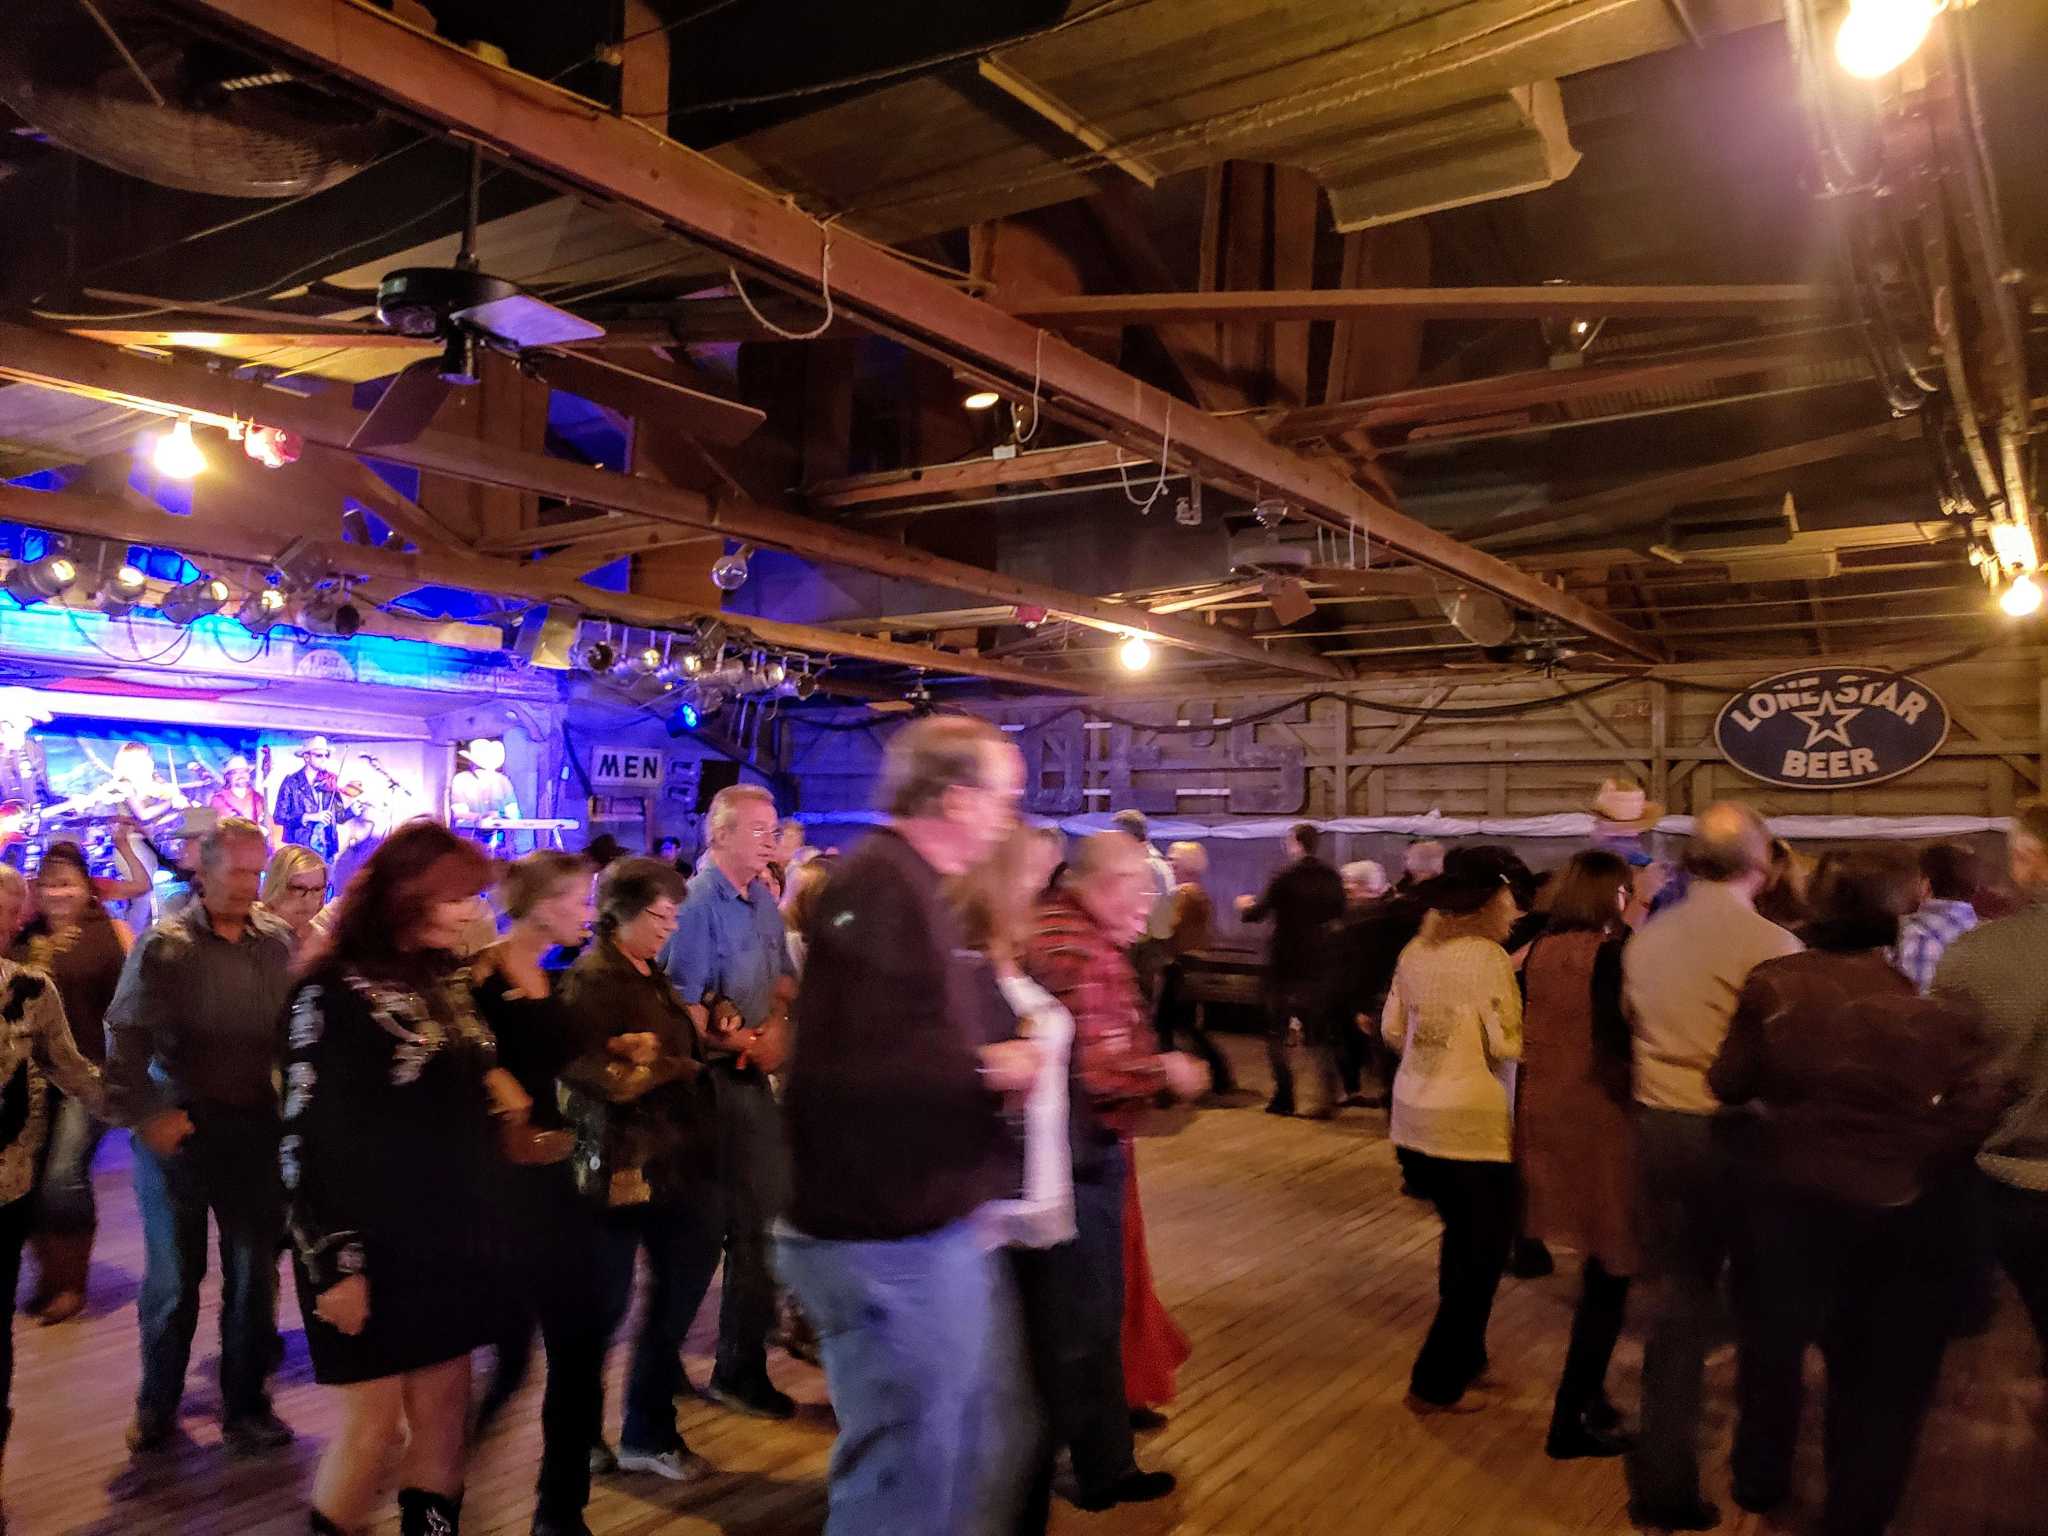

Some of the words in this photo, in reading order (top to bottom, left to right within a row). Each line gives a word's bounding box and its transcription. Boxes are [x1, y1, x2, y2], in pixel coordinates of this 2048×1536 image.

[1730, 676, 1820, 732] LONE
[1835, 675, 1928, 725] STAR
[598, 754, 658, 779] MEN
[1780, 747, 1878, 779] BEER
